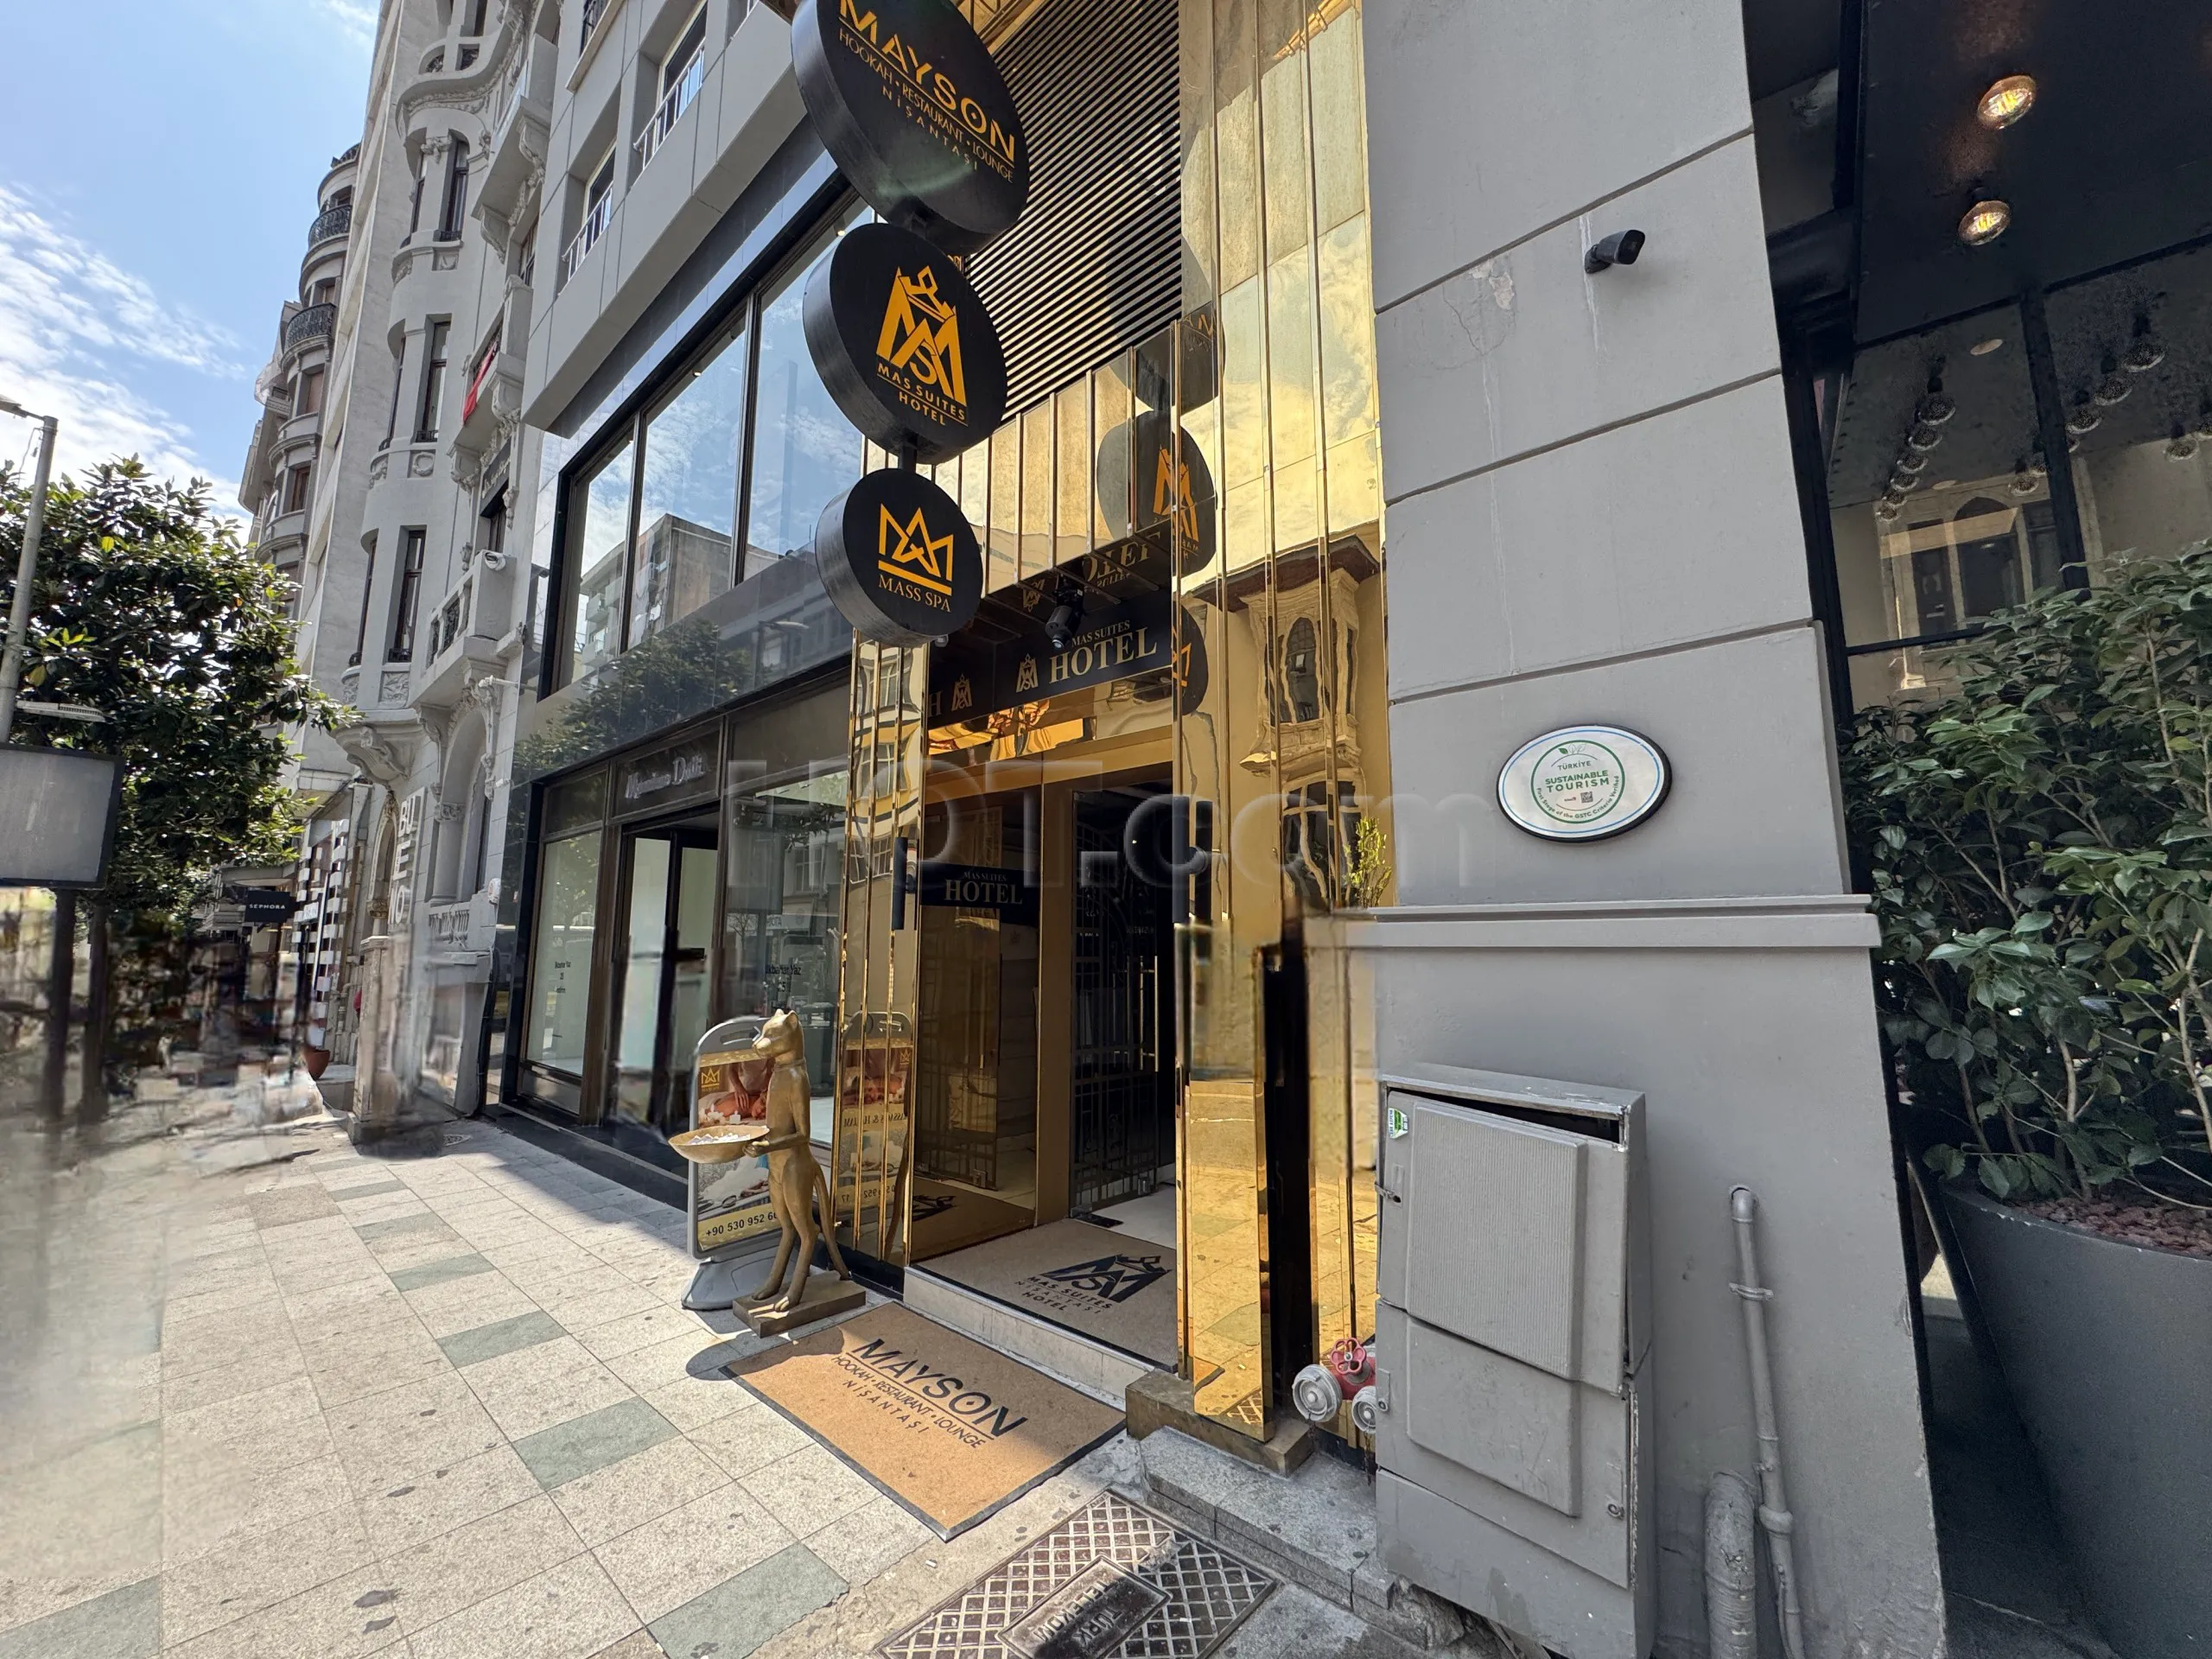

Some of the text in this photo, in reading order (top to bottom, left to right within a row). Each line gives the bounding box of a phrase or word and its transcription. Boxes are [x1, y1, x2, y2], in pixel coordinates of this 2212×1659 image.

[840, 0, 1015, 162] MAYSON
[839, 28, 1014, 183] HOOKAH RESTAURANT LOUNGE
[877, 362, 966, 422] MAS SUITES
[899, 391, 946, 426] HOTEL
[878, 573, 952, 613] MASS SPA
[1071, 620, 1131, 648] MAS SUITES
[1048, 626, 1158, 684] HOTEL
[1545, 770, 1609, 785] SUSTAINABLE
[1557, 760, 1592, 771] TÜRKİYE
[1542, 799, 1555, 812] Stage
[1592, 798, 1613, 814] Criteria
[1610, 775, 1619, 798] Verified
[1547, 778, 1610, 793] TOURISM
[944, 879, 1023, 905] HOTEL
[706, 1224, 724, 1236] +90
[727, 1219, 745, 1232] 530
[747, 1214, 765, 1226] 952
[1022, 1292, 1068, 1311] HOTEL
[1027, 1276, 1113, 1309] MAS SUITES
[831, 1356, 986, 1448] HOOKAH RESTAURANT LOUNGE
[851, 1338, 1029, 1438] MAYSON
[1033, 1580, 1112, 1643] TELEKOM
